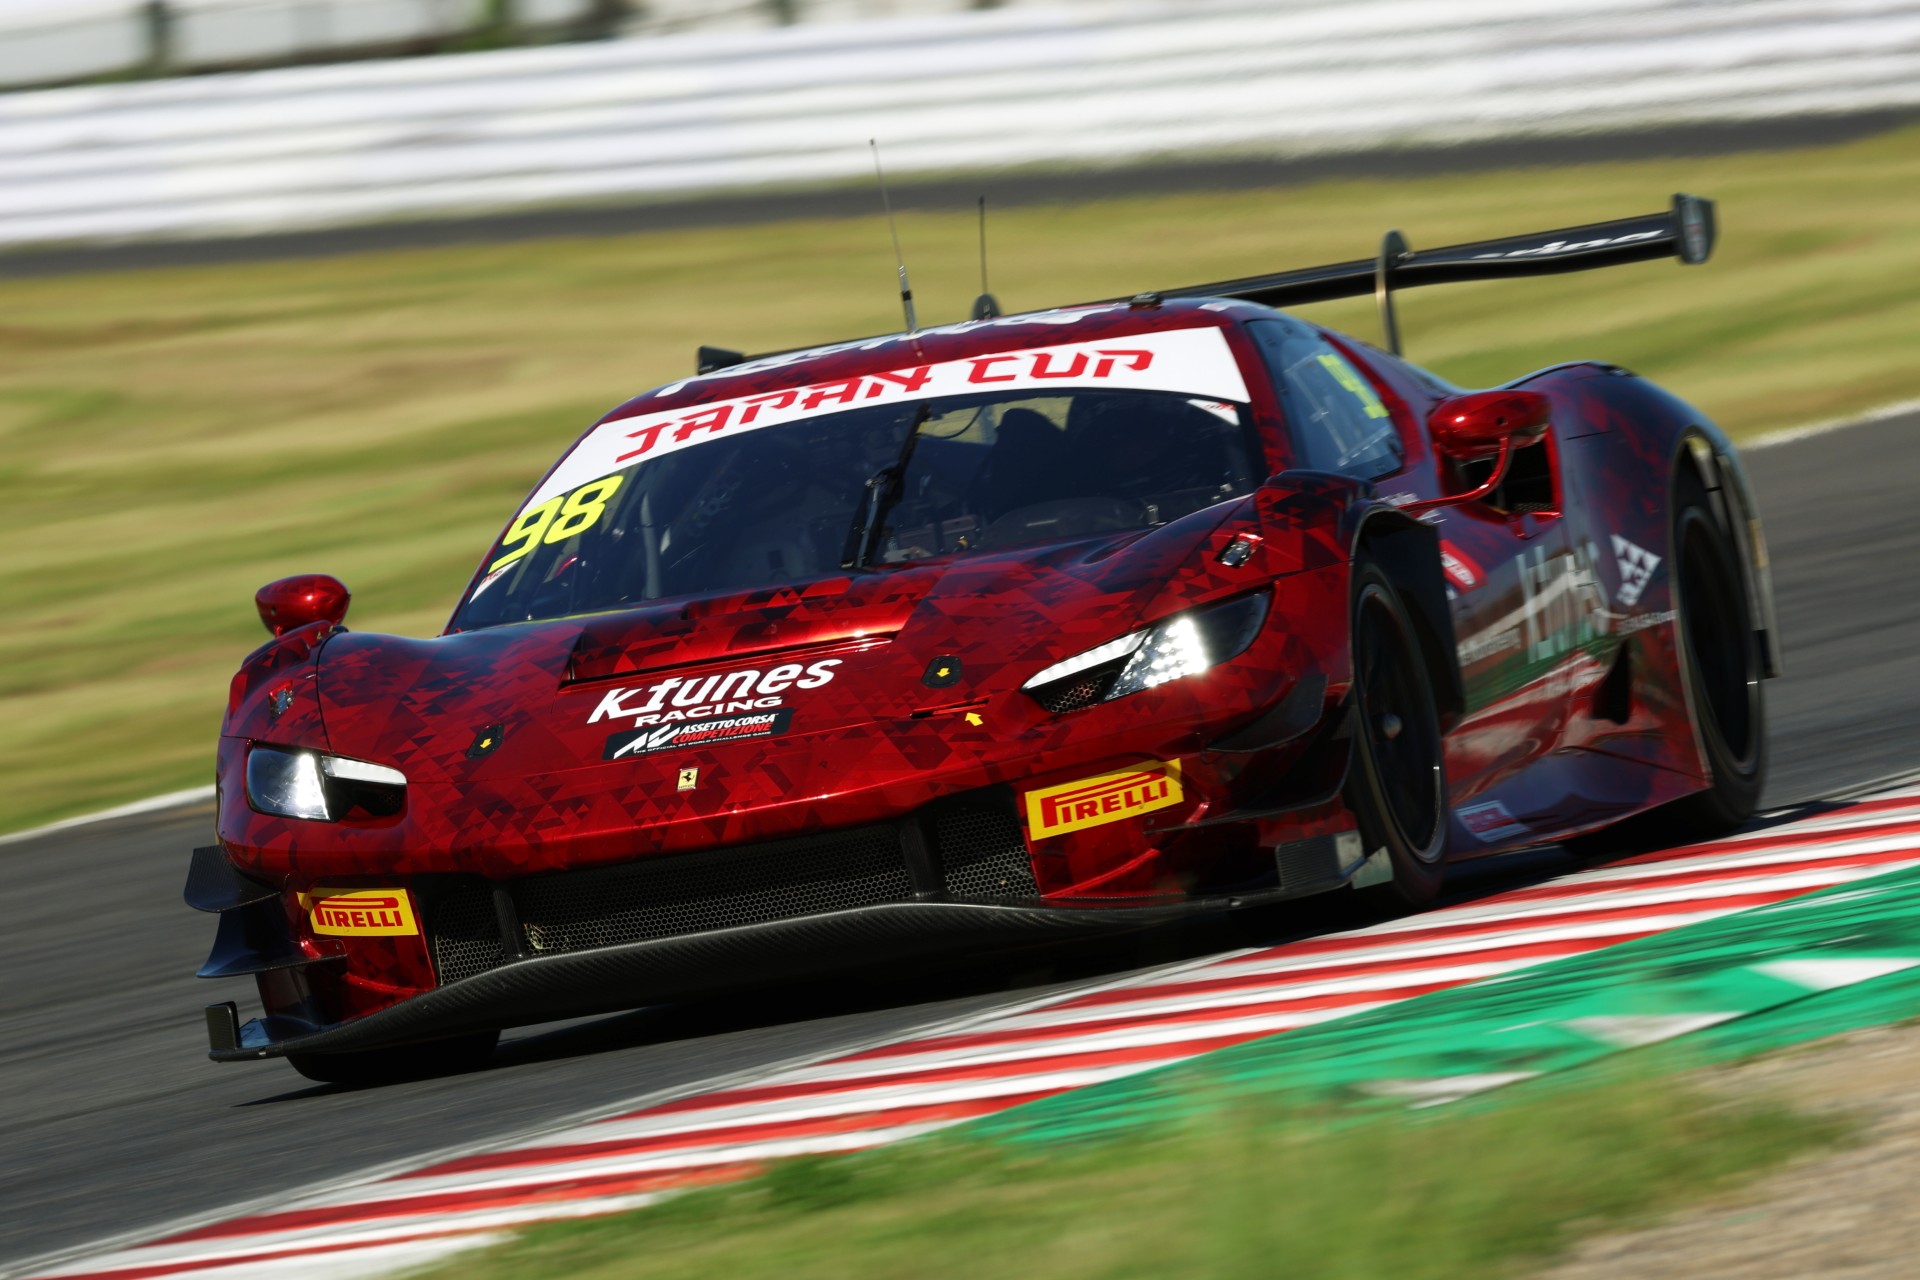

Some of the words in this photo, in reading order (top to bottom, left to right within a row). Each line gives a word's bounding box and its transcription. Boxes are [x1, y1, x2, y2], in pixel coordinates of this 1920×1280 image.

[615, 364, 932, 463] JAPAN
[968, 350, 1154, 384] CUP
[488, 475, 624, 574] 98
[634, 695, 784, 728] RACING
[679, 719, 735, 735] ASSETTO
[735, 713, 776, 727] CORSA
[672, 722, 773, 744] COMPETIZIONE
[1039, 767, 1169, 828] PIRELLI
[310, 896, 404, 927] PIRELLI
